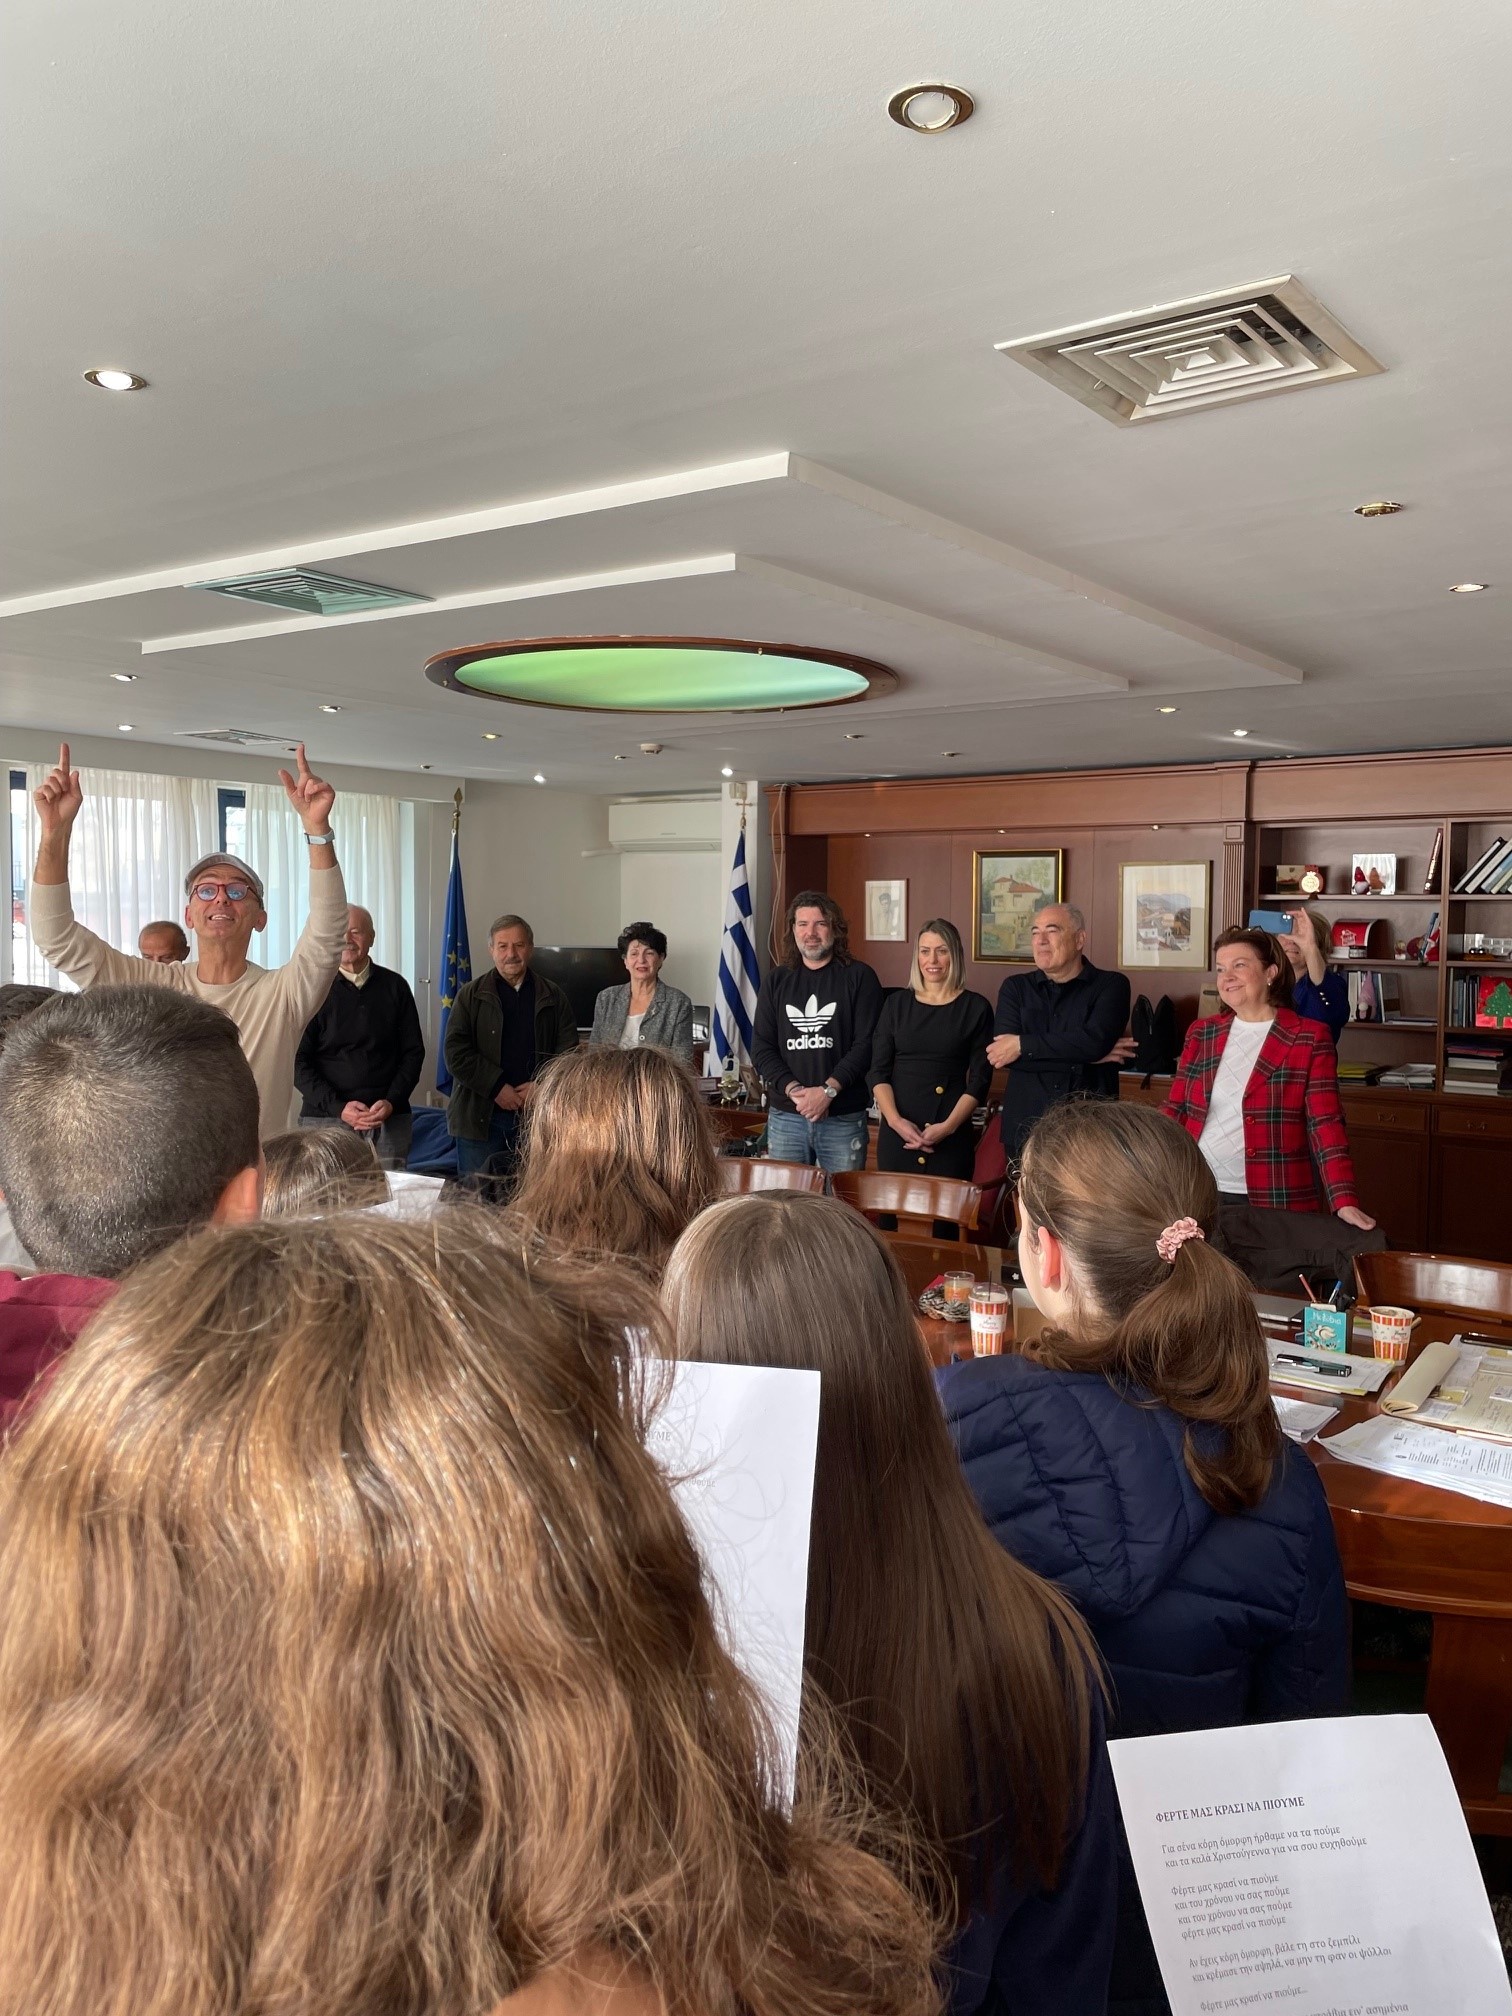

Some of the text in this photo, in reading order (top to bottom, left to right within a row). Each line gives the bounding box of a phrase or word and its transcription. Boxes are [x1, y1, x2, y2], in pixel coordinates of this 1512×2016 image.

[787, 1034, 834, 1050] adidas
[1155, 1796, 1305, 1822] ΦΕΡΤΕ ΜΑΣ ΚΡΑΣΙ ΝΑ ΠΙΟΥΜΕ
[1161, 1825, 1341, 1854] Για σένα κόρη όμορφη ήρθαμε να τα πούμε
[1165, 1836, 1368, 1868] και τα καλά Χριστούγεννα για να σου ευχηθούμε
[1171, 1873, 1279, 1897] Φέρτε μας κρασί να πιούμε
[1174, 1886, 1290, 1910] και του χρόνου να σας πούμε
[1177, 1900, 1293, 1925] και του χρόνου να σας πούμε
[1181, 1915, 1286, 1941] φέρτε μας κρασί να πιούμε
[1189, 1958, 1198, 1968] Αν
[1200, 1955, 1219, 1968] έχεις
[1219, 1952, 1240, 1964] κόρη
[1274, 1942, 1295, 1954] βάλε
[1296, 1941, 1308, 1951] τη
[1309, 1940, 1326, 1949] στο
[1327, 1934, 1361, 1949] ζεμπίλι
[1206, 1968, 1238, 1981] κρέμασε
[1239, 1966, 1253, 1976] την
[1284, 1958, 1295, 1967] να
[1296, 1955, 1313, 1966] μην
[1314, 1954, 1326, 1964] τη
[1327, 1952, 1347, 1963] φαν
[1348, 1950, 1358, 1959] οι
[1359, 1946, 1392, 1960] ψύλλοι
[1224, 1998, 1239, 2009] μας
[1262, 1992, 1273, 2000] να
